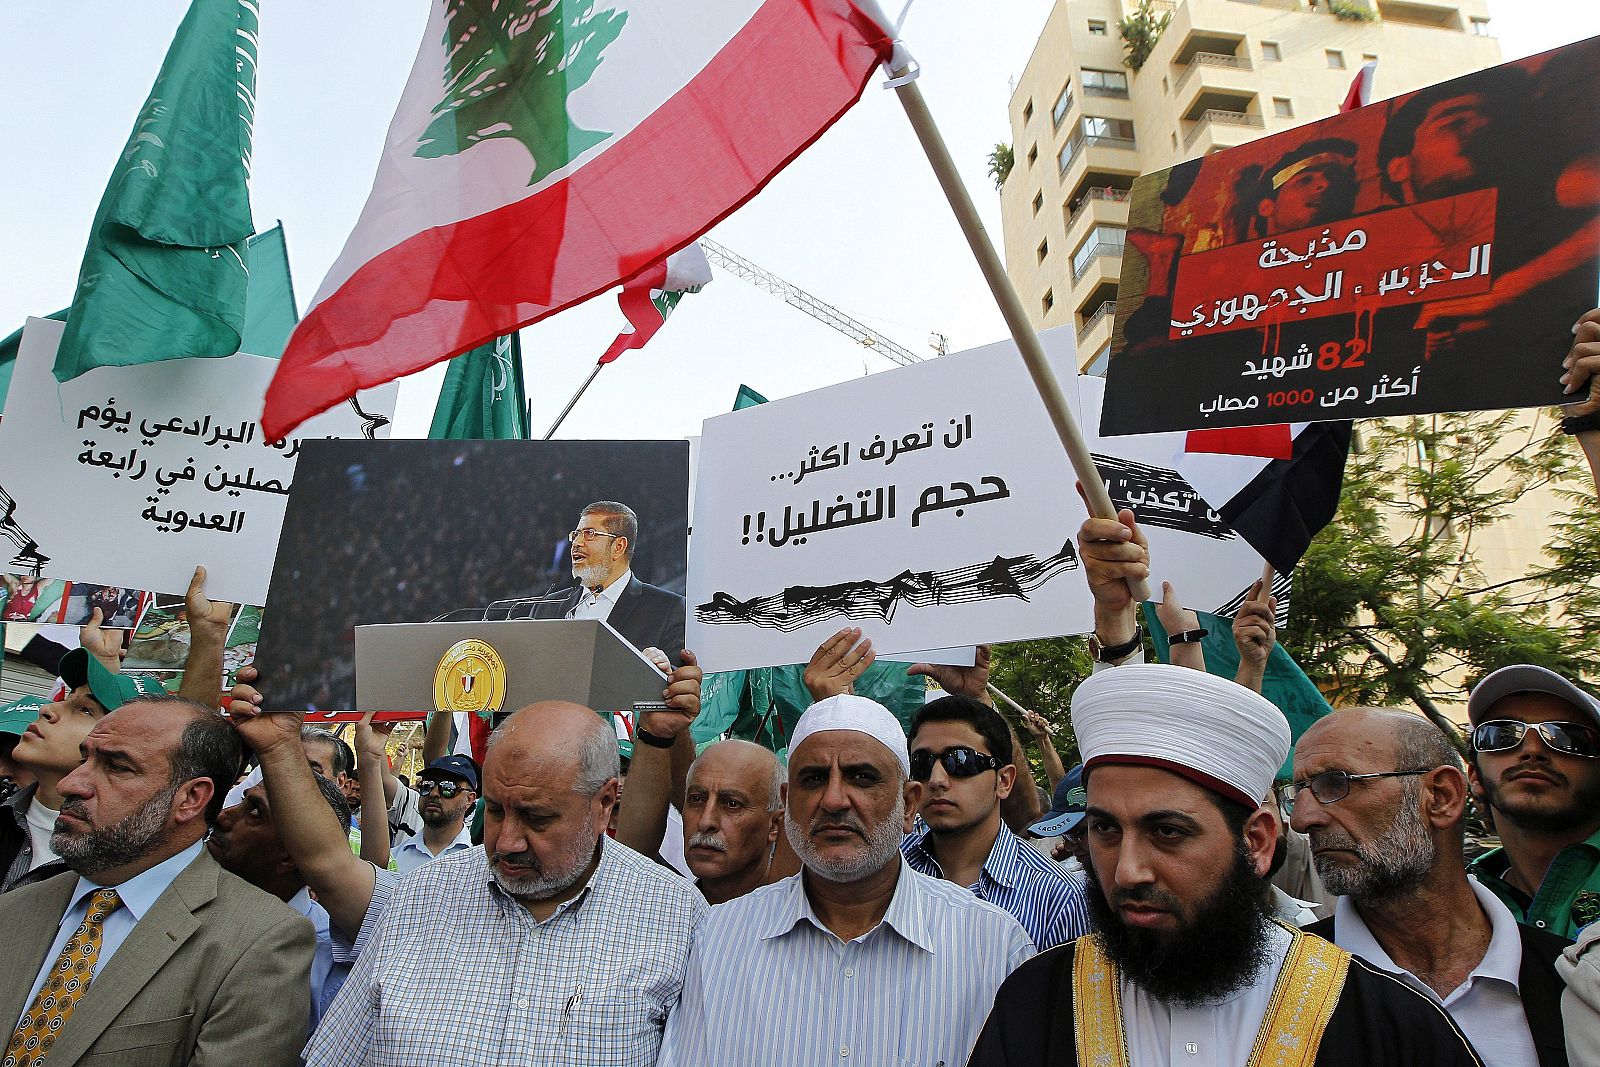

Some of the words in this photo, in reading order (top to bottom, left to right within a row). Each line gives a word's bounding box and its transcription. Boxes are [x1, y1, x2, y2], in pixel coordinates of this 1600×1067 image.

[1258, 228, 1367, 269] مذبحة
[1241, 343, 1313, 381] شهيد
[1317, 339, 1366, 369] 82
[1267, 388, 1315, 407] 1000
[1320, 384, 1358, 408] من
[1366, 365, 1421, 404] أكثر
[76, 397, 132, 433] يؤم
[1199, 392, 1259, 418] مصاب
[140, 414, 255, 449] البرادعي
[859, 422, 934, 466] تعرف
[943, 414, 973, 449] ان
[77, 439, 147, 480] رابعة
[156, 457, 196, 495] في
[141, 495, 246, 534] العدوية
[741, 485, 897, 547] التضليل!!
[911, 474, 1010, 528] حجم
[1038, 817, 1072, 832] LACOSTE
